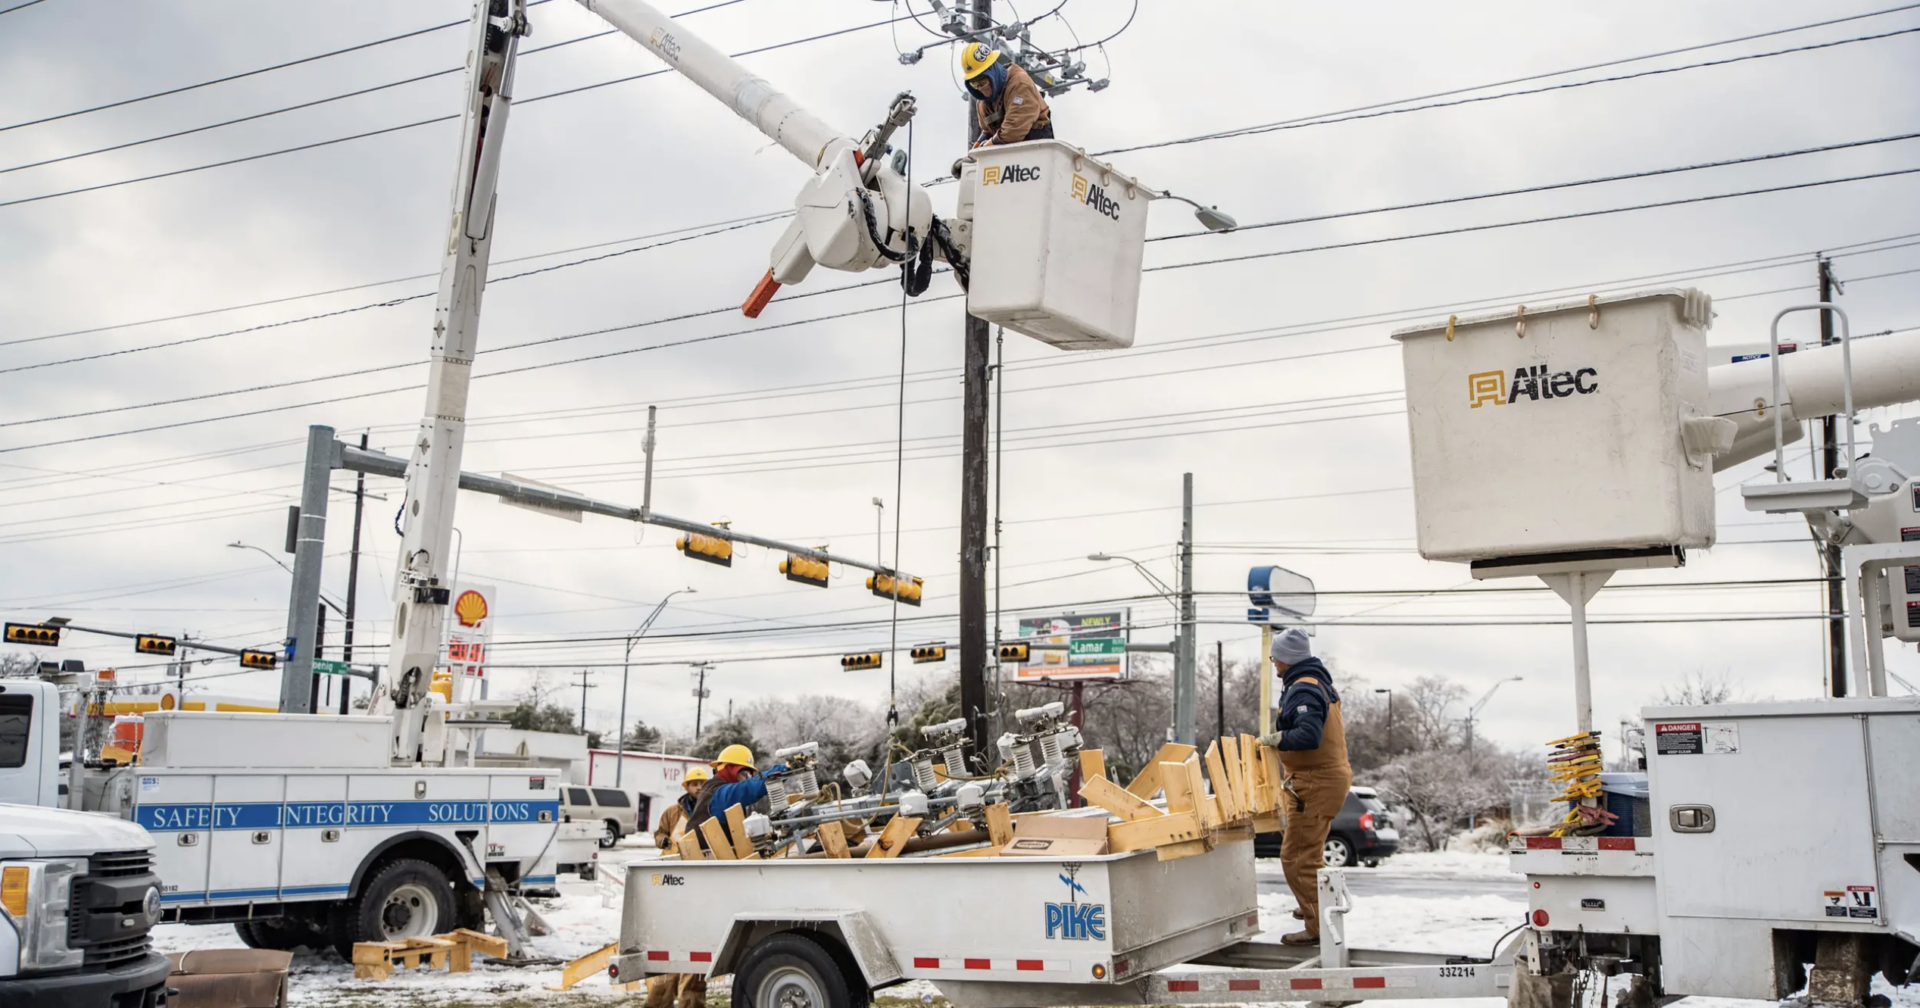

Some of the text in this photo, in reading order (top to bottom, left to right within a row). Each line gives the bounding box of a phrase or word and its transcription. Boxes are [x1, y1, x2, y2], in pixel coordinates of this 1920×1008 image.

[659, 33, 681, 61] Altec
[1000, 164, 1041, 184] Altec
[1086, 184, 1120, 221] Altec
[1508, 364, 1599, 404] Altec
[1081, 616, 1111, 626] NEWLY
[1075, 641, 1104, 653] Lamar
[663, 767, 681, 781] VIP
[153, 803, 529, 828] SAFETY INTEGRITY SOLUTIONS
[662, 874, 685, 886] Altec
[1045, 902, 1106, 941] PIKE
